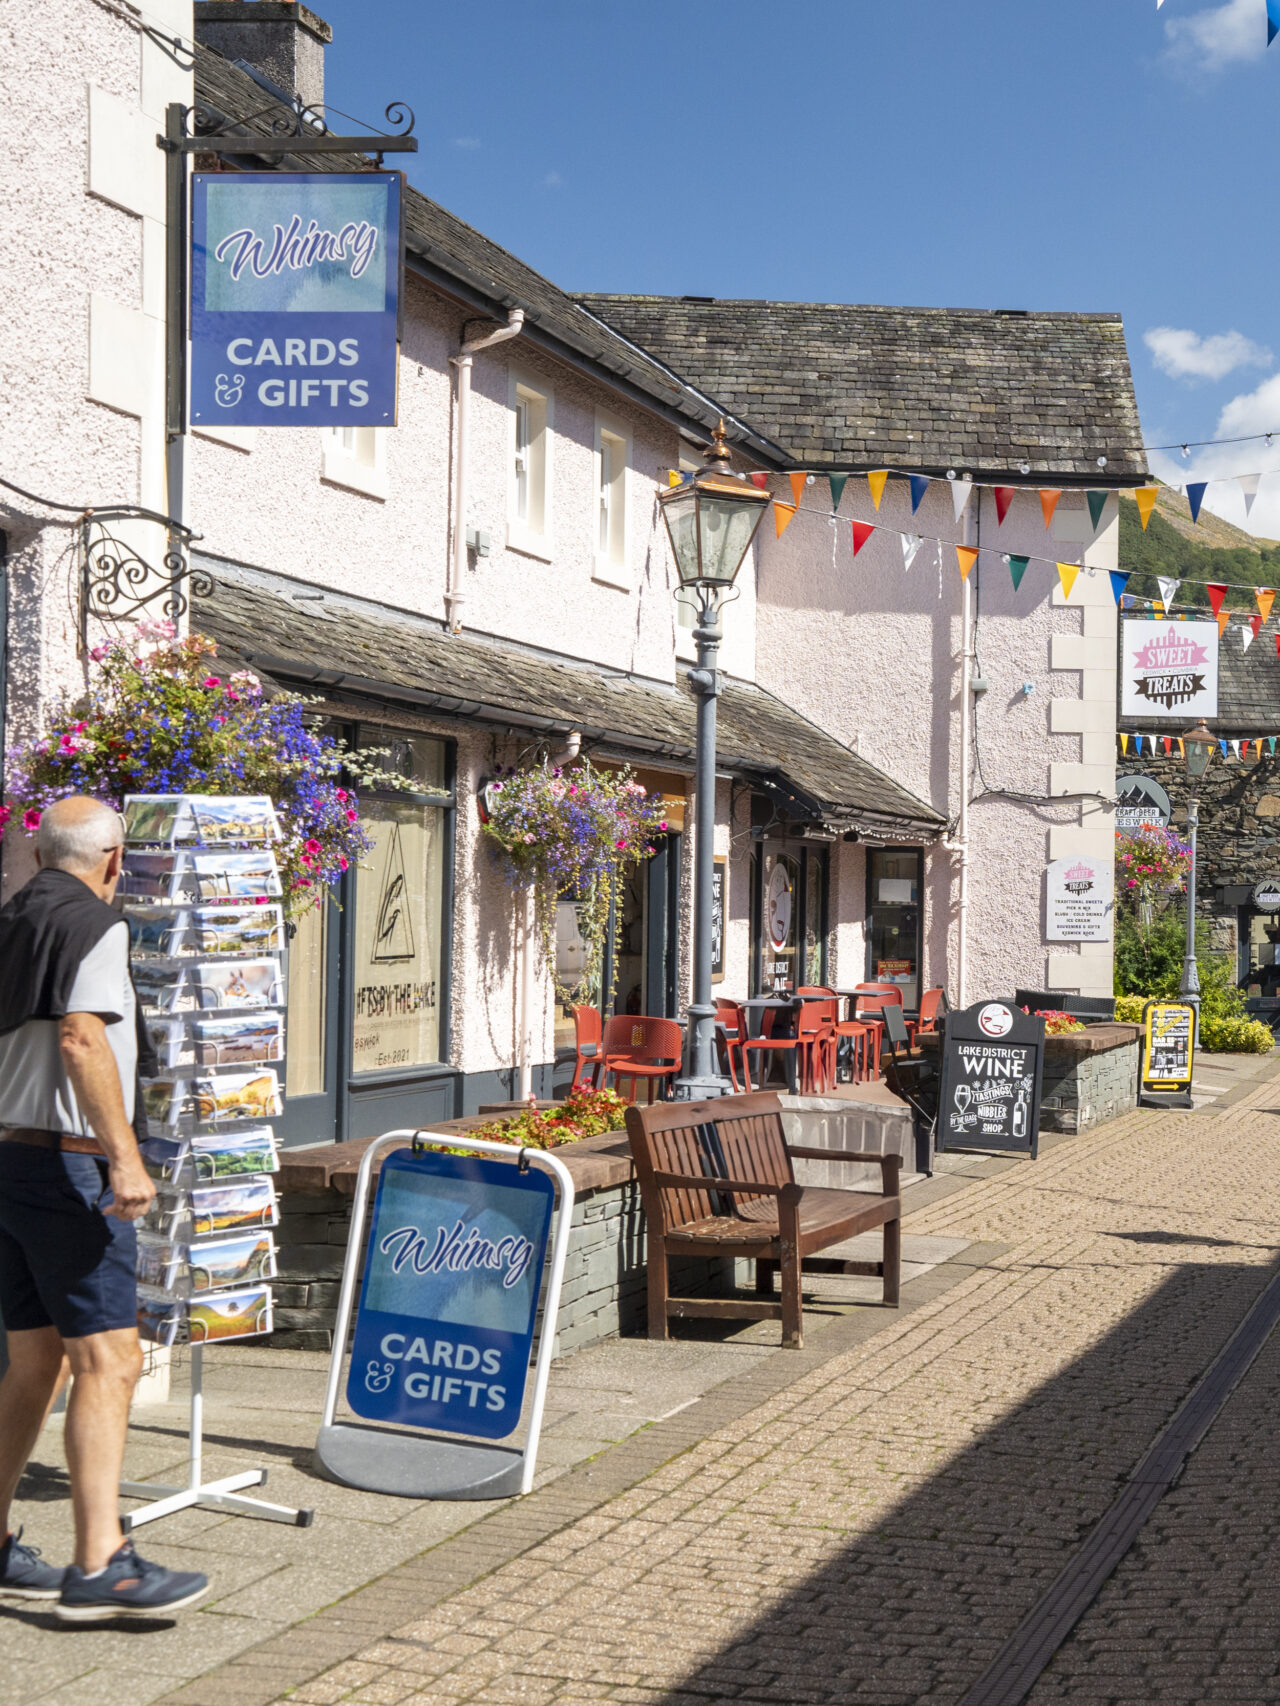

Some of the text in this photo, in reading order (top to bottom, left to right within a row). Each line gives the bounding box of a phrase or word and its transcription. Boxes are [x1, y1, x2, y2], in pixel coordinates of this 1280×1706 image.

[215, 214, 378, 281] Whimsy
[226, 338, 359, 366] CARDS
[215, 373, 369, 407] & GIFTS
[1146, 646, 1196, 667] SWEET
[1172, 667, 1198, 675] CUMBRIA
[1146, 674, 1194, 694] TREATS
[1138, 808, 1156, 816] BEER
[1117, 818, 1163, 826] ESWICK
[1069, 881, 1089, 890] TREATS
[354, 1032, 380, 1050] eswick
[958, 1045, 1027, 1060] LAKE DISTRICT
[962, 1056, 1025, 1078] WINE
[974, 1085, 1010, 1102] TASTINGS
[977, 1105, 1007, 1119] NIBBLES
[982, 1122, 1003, 1133] SHOP
[380, 1219, 534, 1289] Whimsy
[380, 1333, 501, 1375] CARDS
[365, 1360, 506, 1412] & GIFTS
